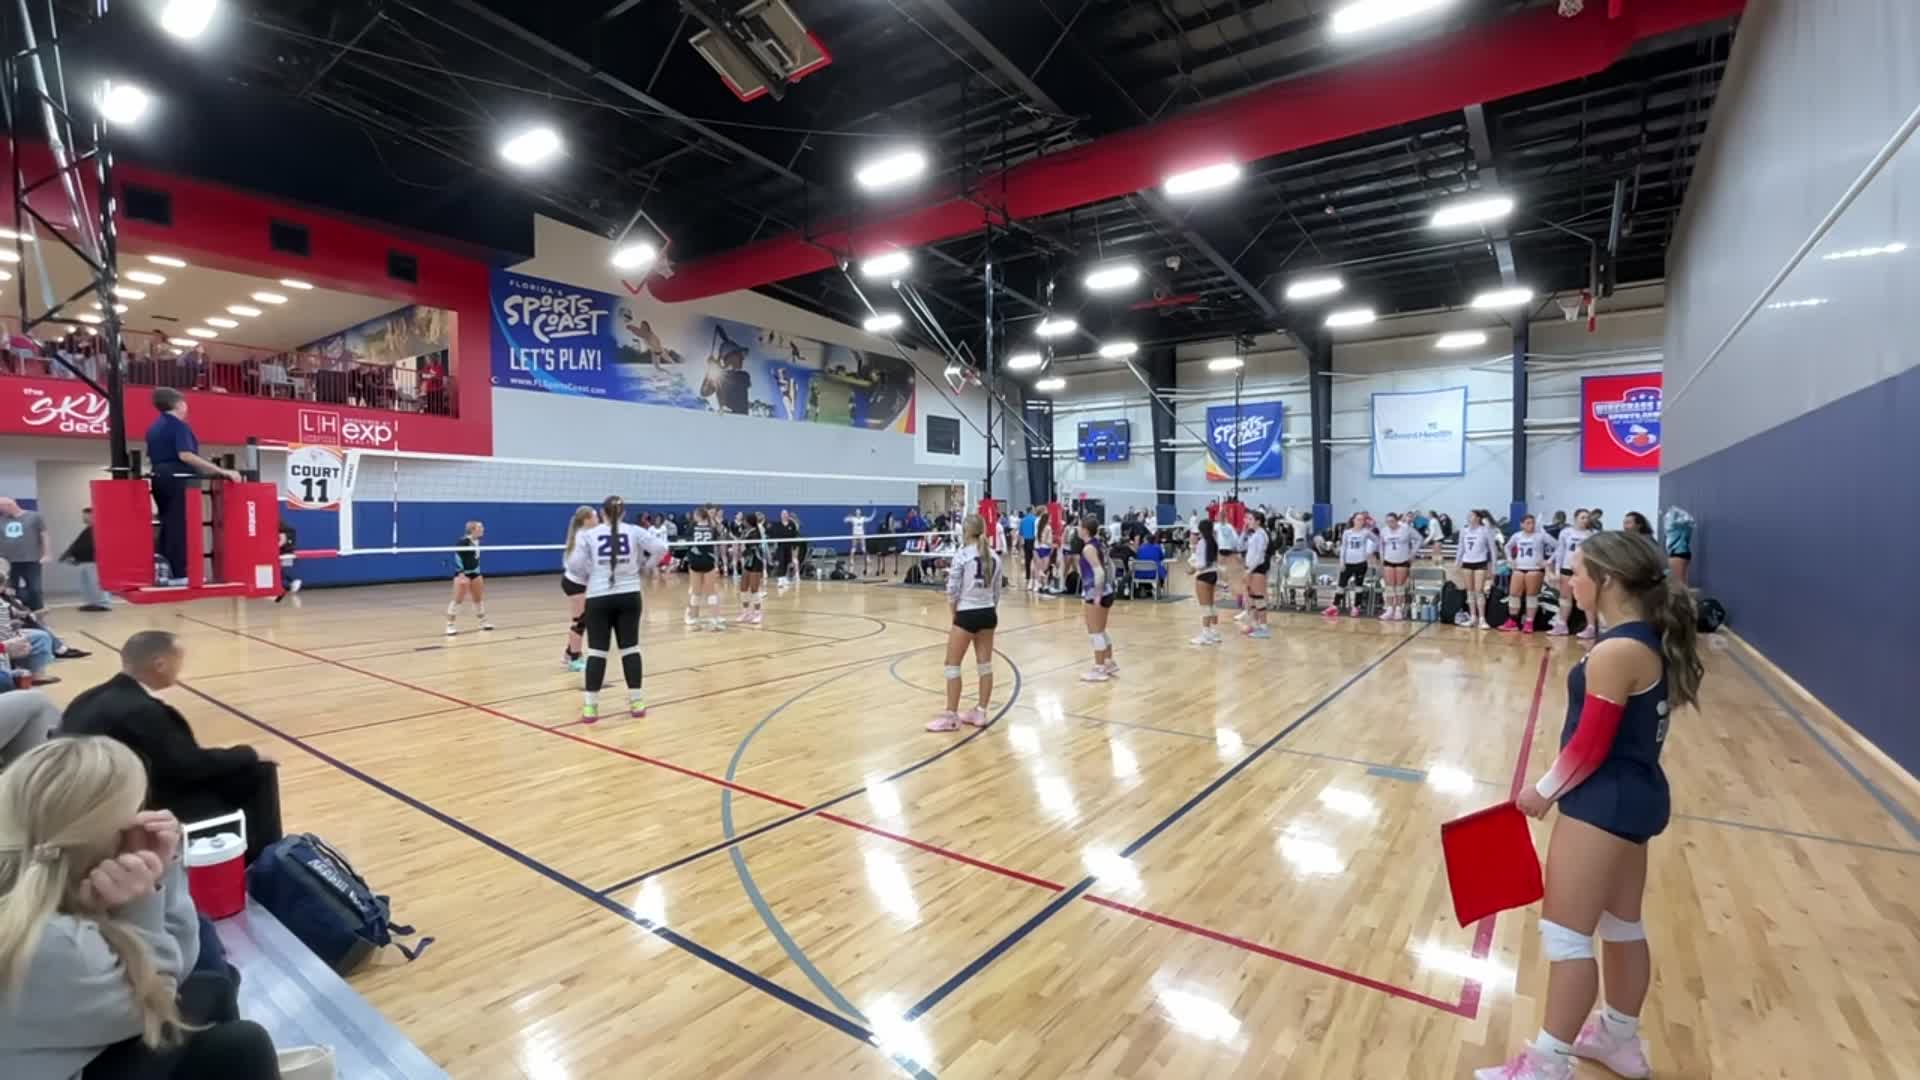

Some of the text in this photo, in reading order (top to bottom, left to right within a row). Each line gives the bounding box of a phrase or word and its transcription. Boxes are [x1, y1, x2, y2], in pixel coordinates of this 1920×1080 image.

[503, 294, 593, 326] SPORTS
[533, 310, 609, 344] COAST
[510, 347, 602, 371] LET'S PLAY!
[290, 465, 340, 478] COURT
[300, 478, 329, 503] 11
[694, 531, 712, 544] 22
